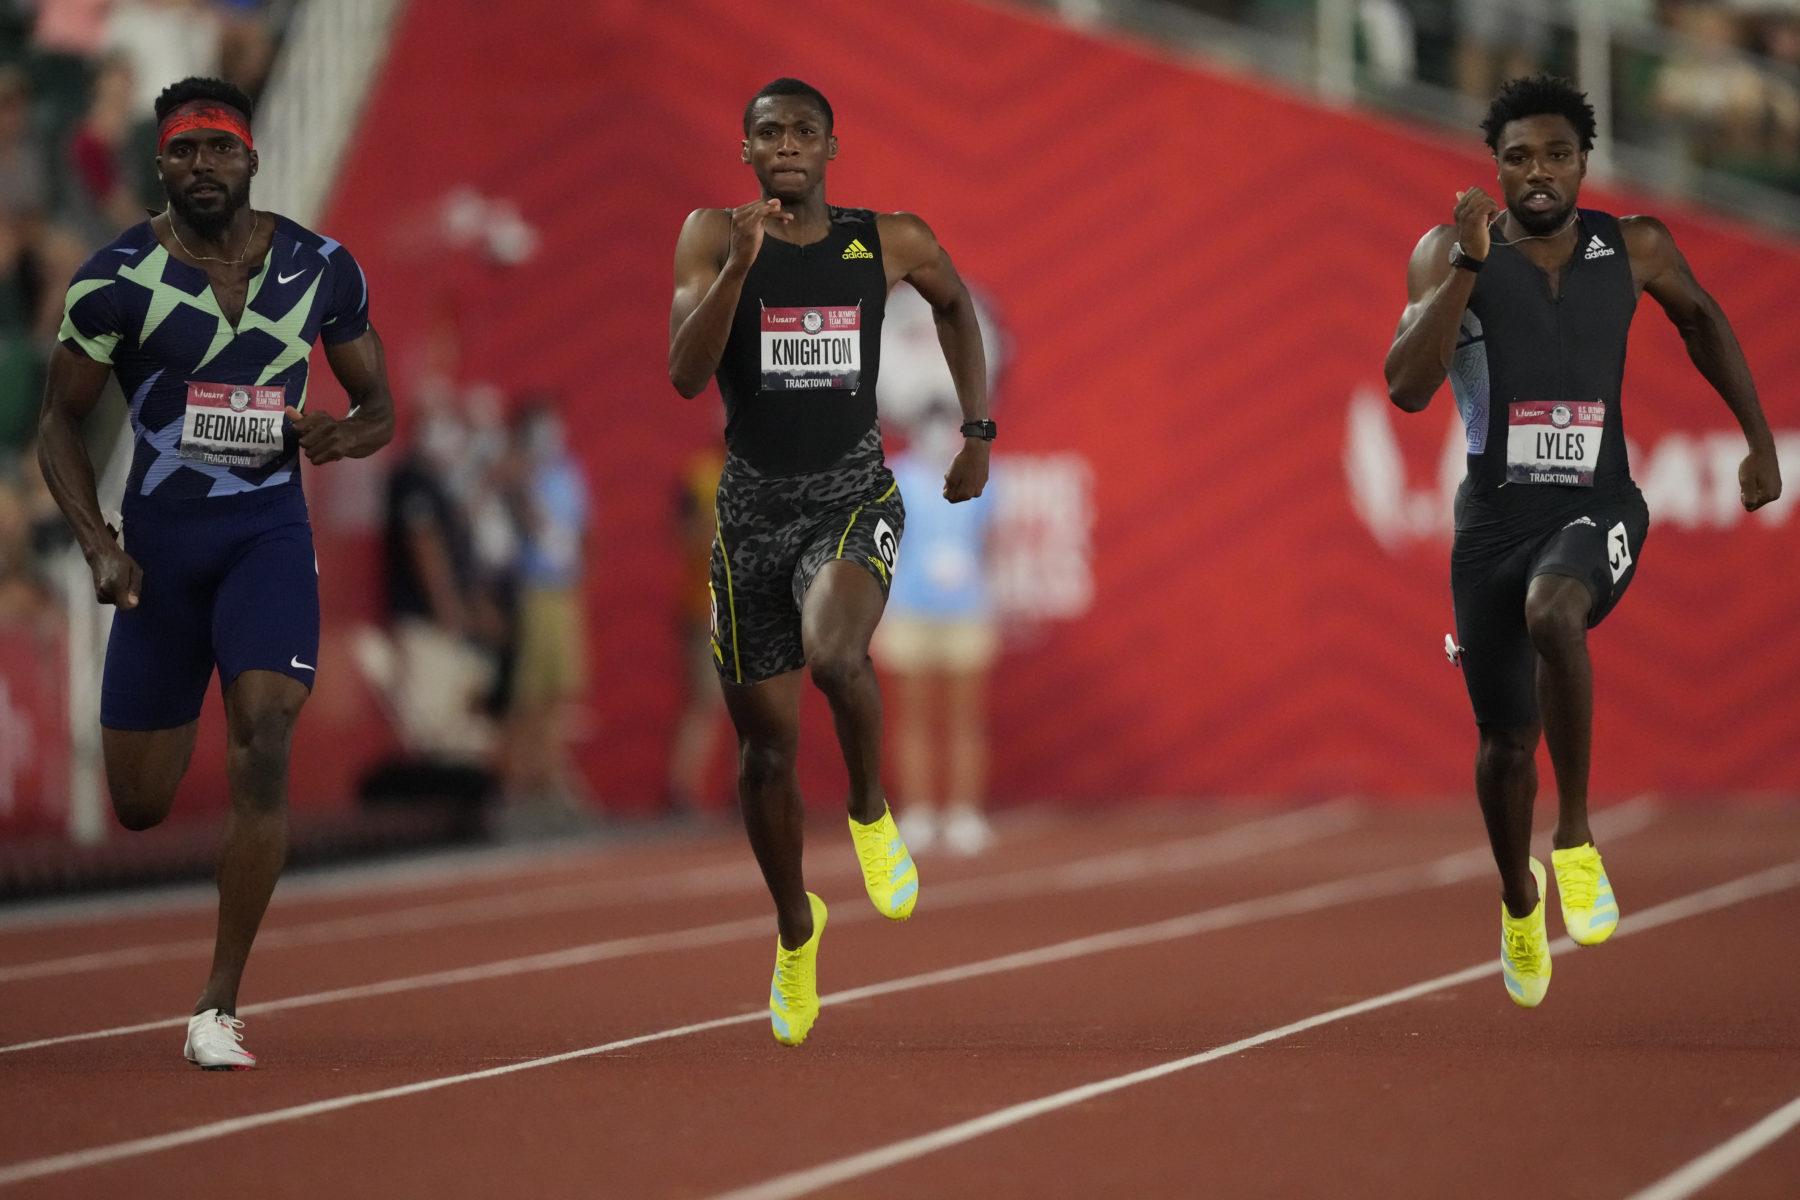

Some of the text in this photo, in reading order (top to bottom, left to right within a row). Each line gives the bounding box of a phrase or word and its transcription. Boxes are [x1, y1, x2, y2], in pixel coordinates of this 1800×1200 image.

[842, 250, 874, 260] adidas
[1584, 247, 1615, 260] adidas
[772, 337, 853, 366] KNIGHTON
[784, 378, 833, 389] TRACKTOWN
[193, 412, 276, 444] BEDNAREK
[1536, 431, 1585, 461] LYLES
[203, 452, 251, 465] TRACKTOWN
[1529, 472, 1579, 484] TRACKTOWN
[880, 531, 897, 569] 6
[1609, 533, 1627, 571] 5
